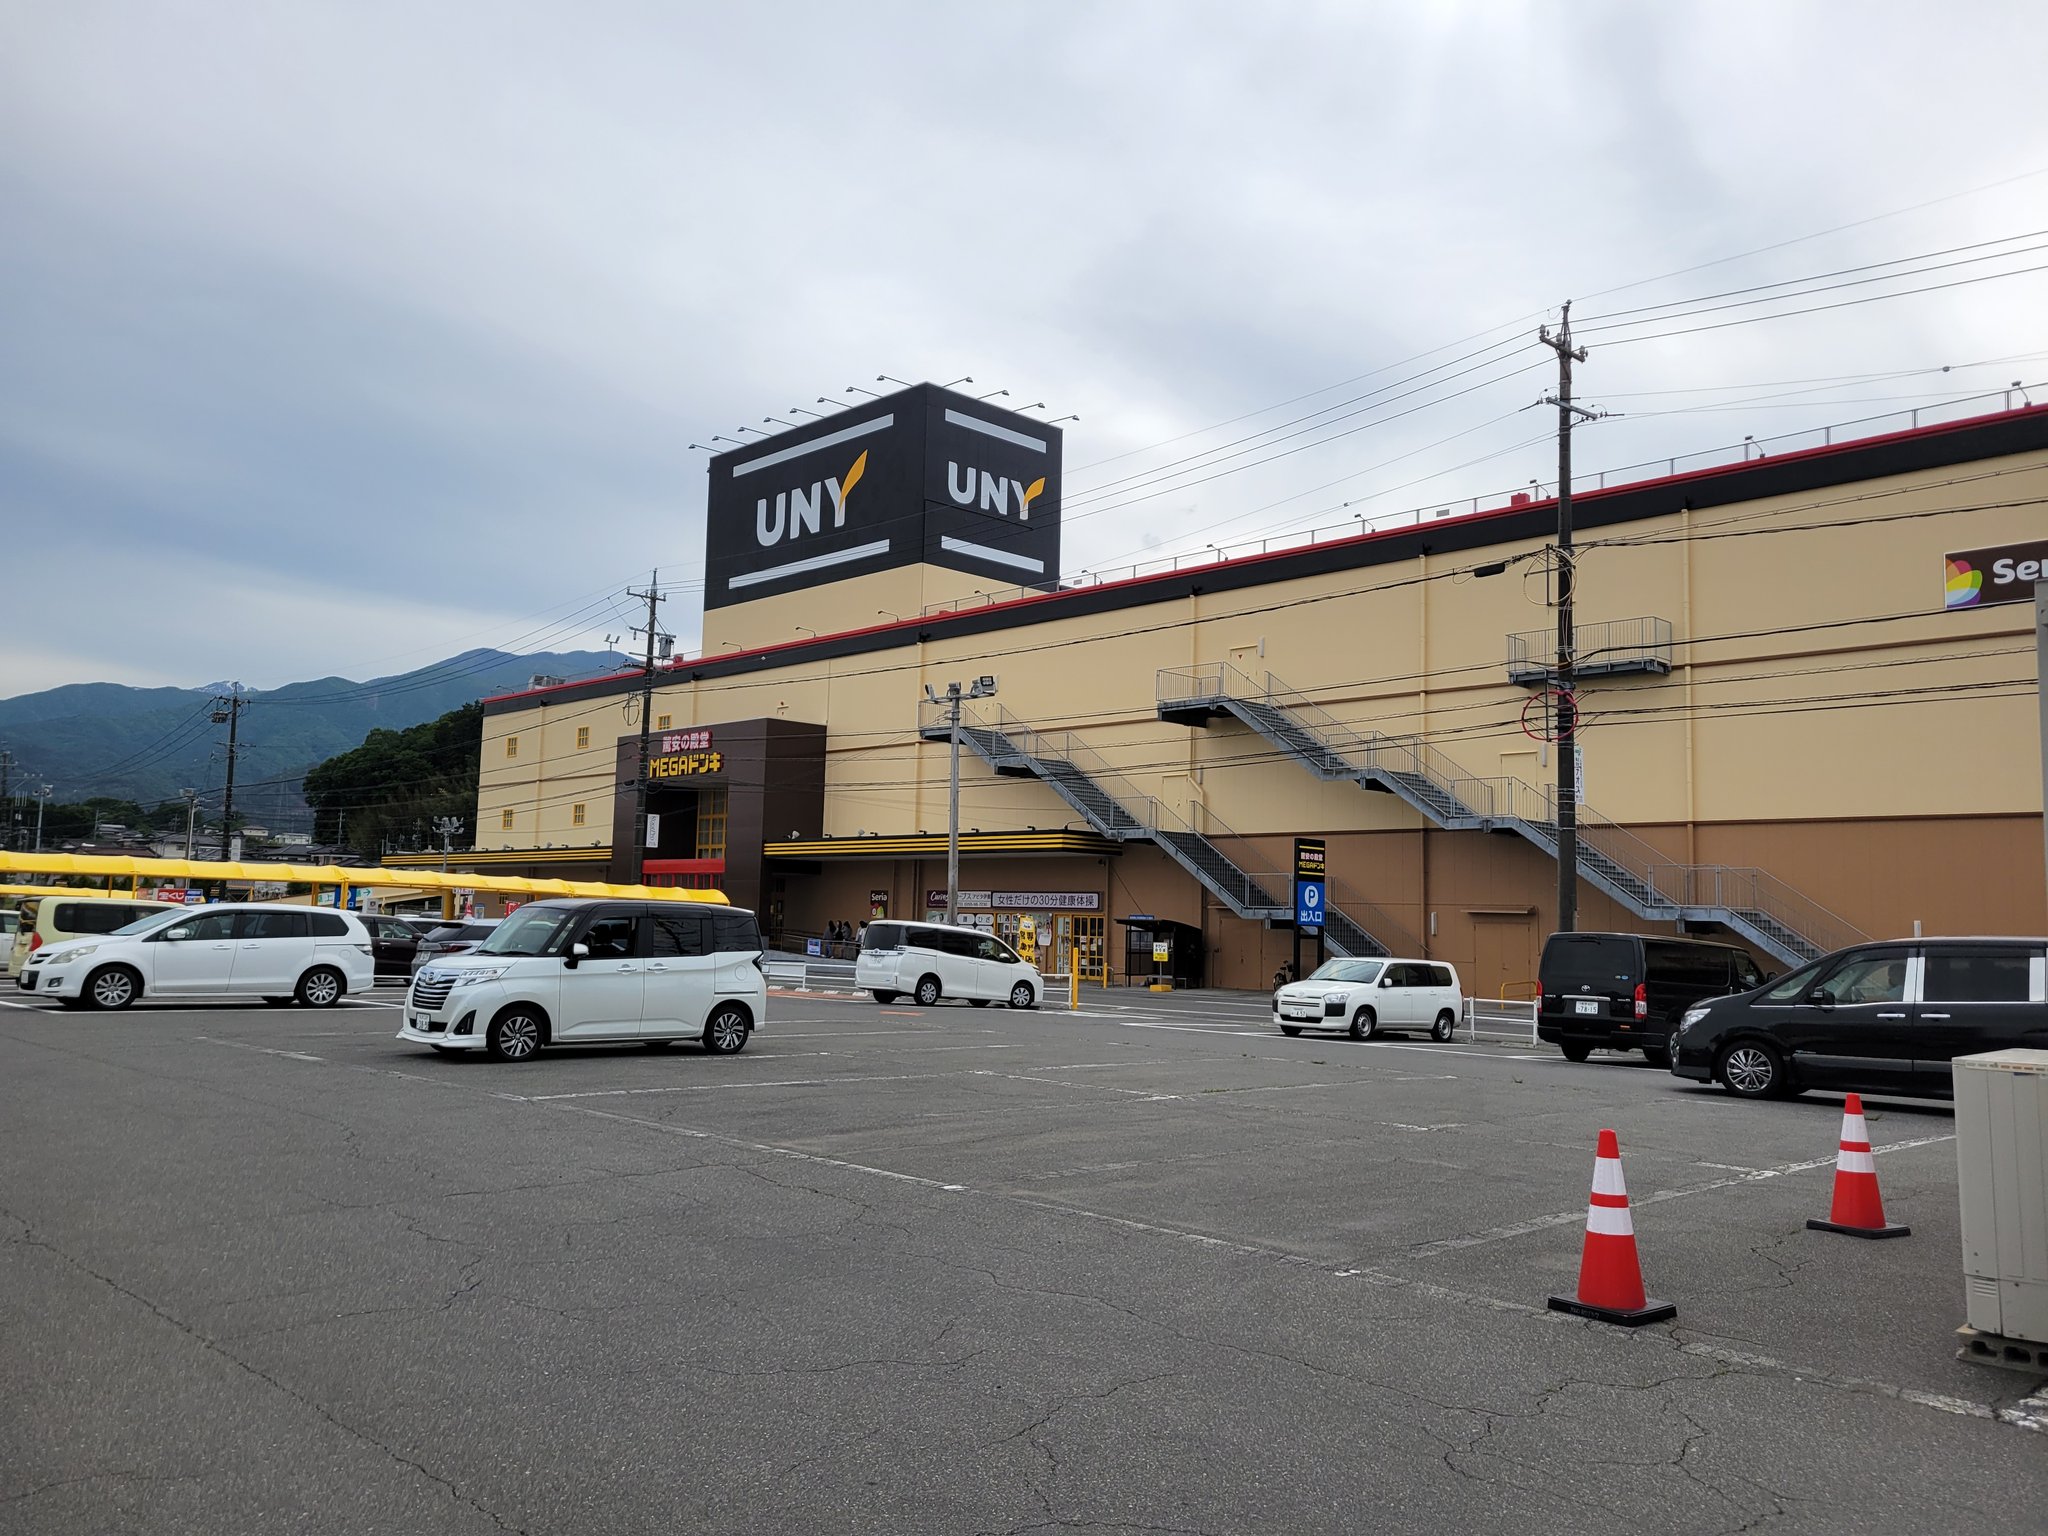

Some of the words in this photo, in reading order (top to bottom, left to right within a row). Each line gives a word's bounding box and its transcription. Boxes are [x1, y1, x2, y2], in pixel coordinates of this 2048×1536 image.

[756, 449, 868, 547] UNY
[947, 460, 1046, 521] UNY
[649, 752, 721, 778] MEGAドンキ
[871, 892, 888, 901] Seria
[997, 894, 1095, 907] 女性だけの30分健康体操
[1300, 910, 1323, 922] 出入口
